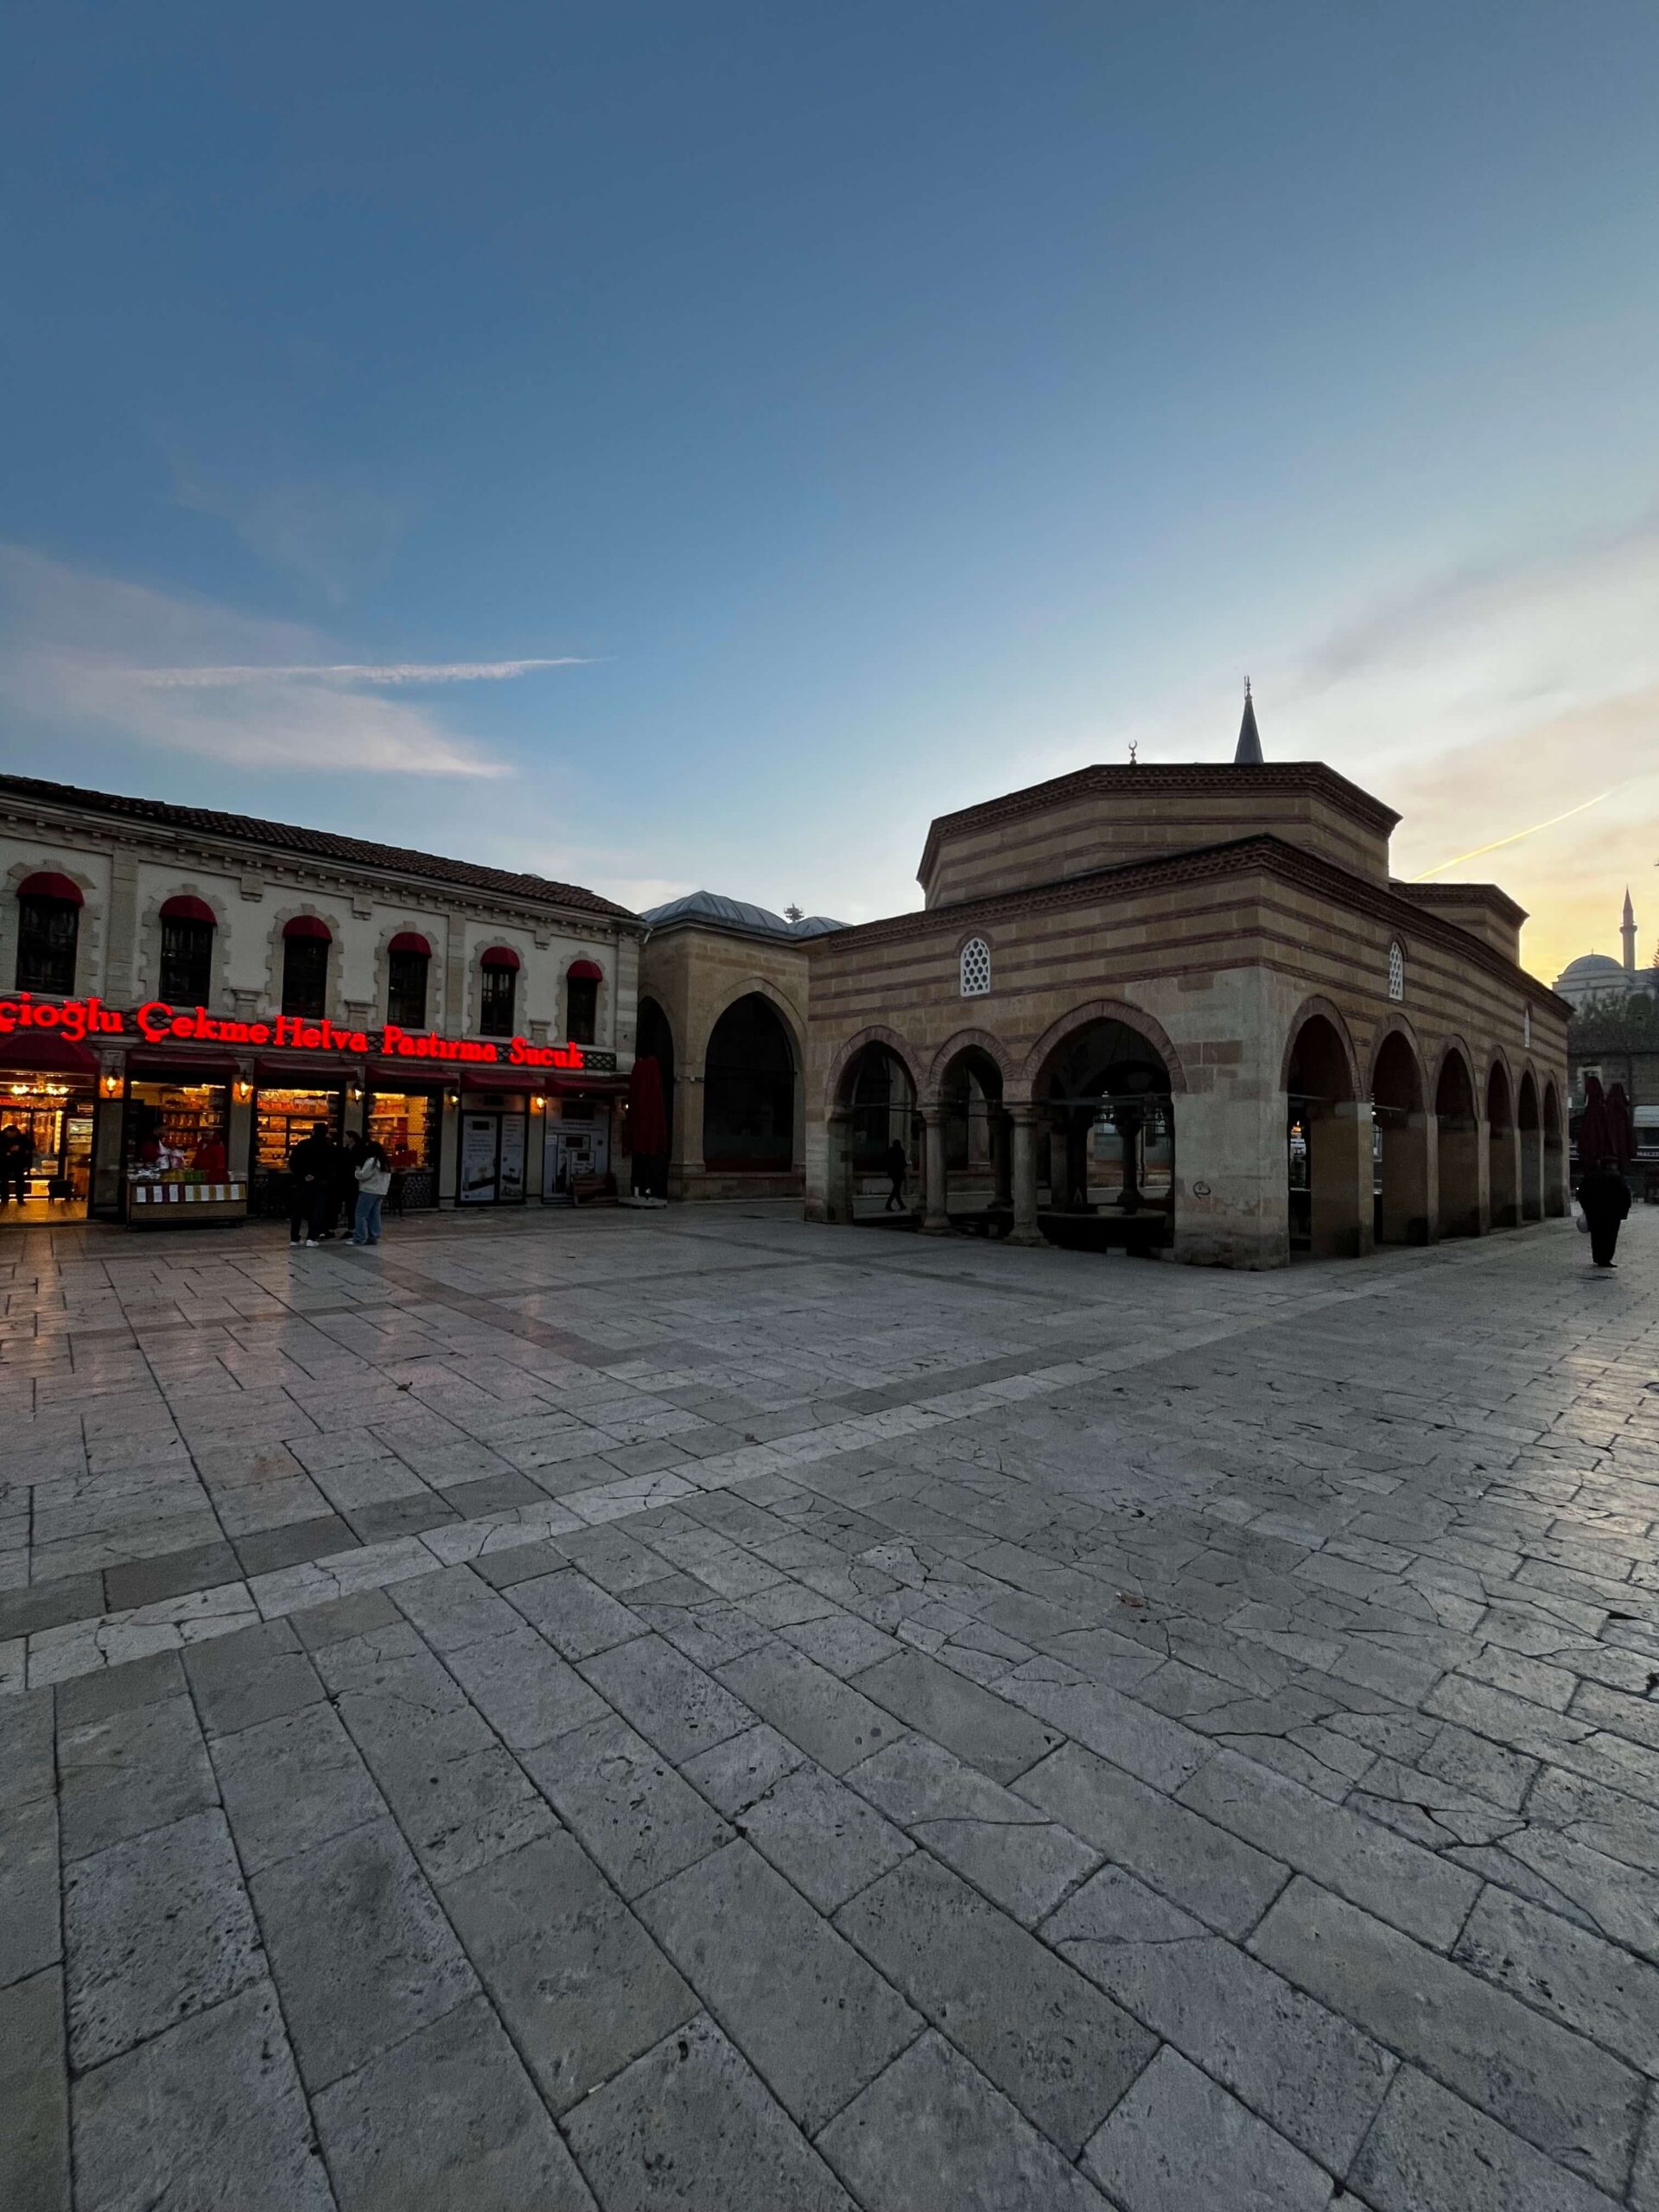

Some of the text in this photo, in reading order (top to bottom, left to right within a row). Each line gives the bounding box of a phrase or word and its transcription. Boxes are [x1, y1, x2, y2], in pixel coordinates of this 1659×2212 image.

[137, 1001, 270, 1044] Çekme
[273, 1014, 368, 1052] Helva
[381, 1025, 498, 1063] Pastırma
[509, 1037, 585, 1069] Sucuk
